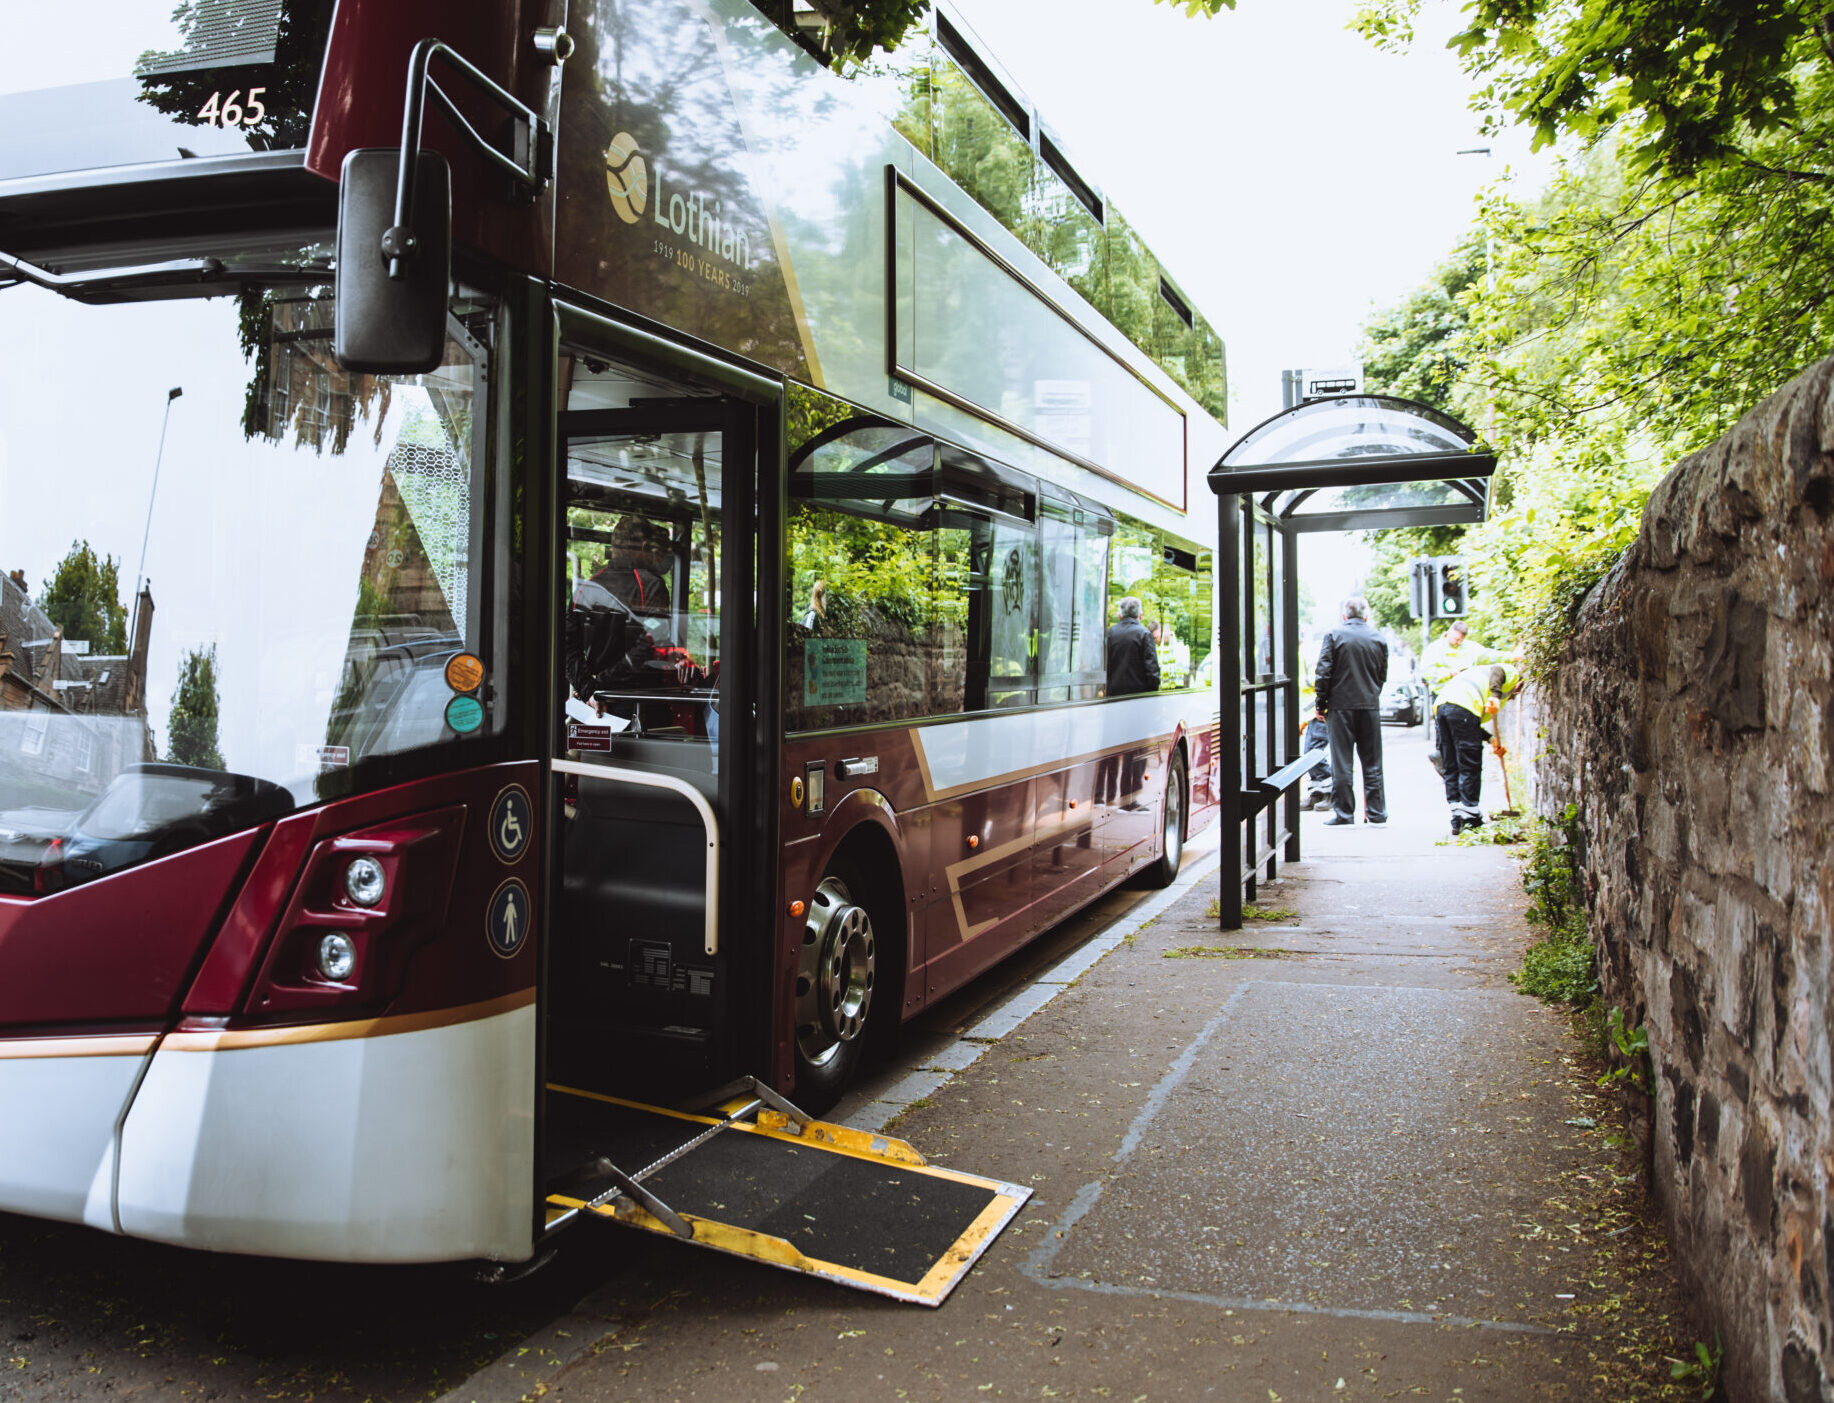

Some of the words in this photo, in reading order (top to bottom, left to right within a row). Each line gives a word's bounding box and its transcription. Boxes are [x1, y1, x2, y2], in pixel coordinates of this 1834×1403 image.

[197, 87, 266, 127] 465
[654, 162, 751, 271] Lothian
[653, 239, 674, 260] 1919
[676, 247, 696, 273] 100
[698, 258, 731, 290] YEARS
[732, 279, 750, 298] 2019
